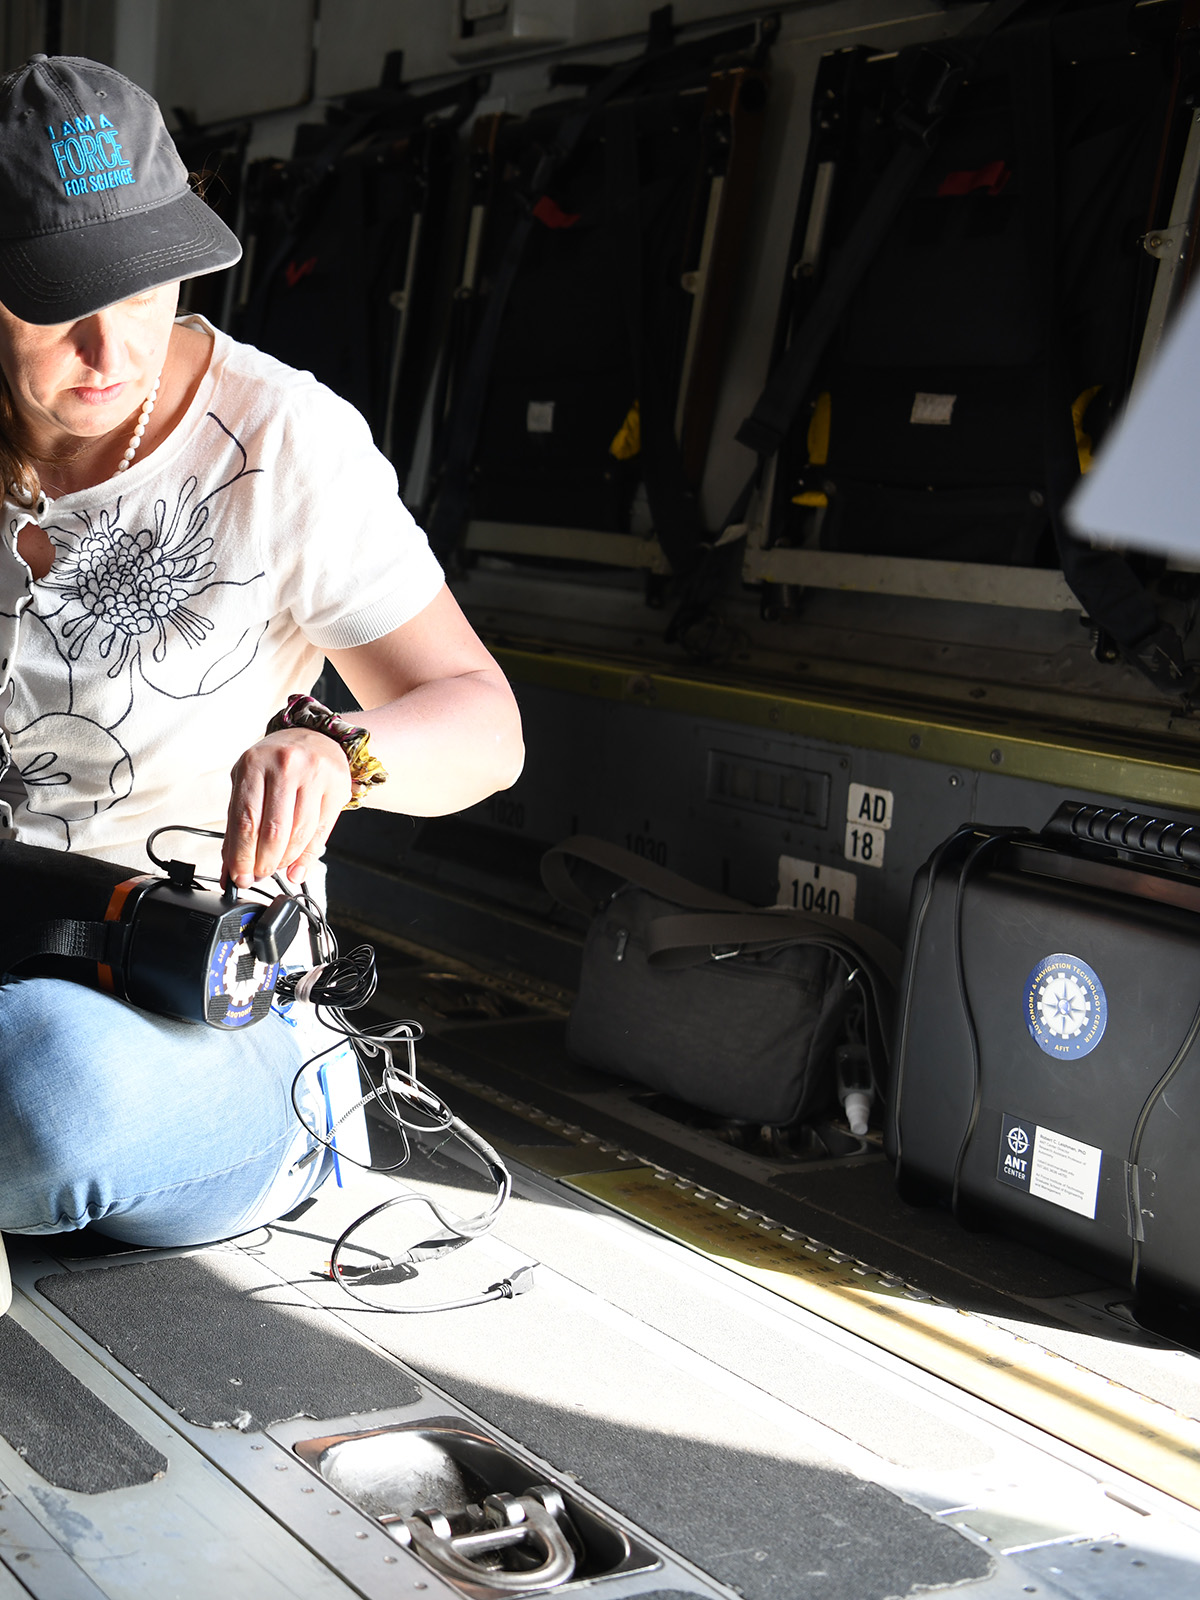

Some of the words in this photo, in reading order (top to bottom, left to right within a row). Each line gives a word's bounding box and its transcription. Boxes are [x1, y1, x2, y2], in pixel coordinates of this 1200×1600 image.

[48, 126, 55, 140] I
[62, 114, 96, 136] AM
[99, 114, 114, 128] A
[52, 130, 130, 178] FORCE
[64, 178, 88, 196] FOR
[88, 167, 136, 192] SCIENCE
[859, 792, 886, 823] AD
[851, 829, 873, 860] 18
[792, 879, 840, 916] 1040
[1035, 963, 1072, 983] NAVIGATION
[1073, 966, 1101, 1012] TECHNOLOGY
[1028, 990, 1042, 1034] AUTONOMY
[1084, 1014, 1100, 1043] CENTER
[1054, 1044, 1070, 1052] AFIT
[1004, 1154, 1028, 1172] ANT
[1004, 1166, 1026, 1181] CENTER
